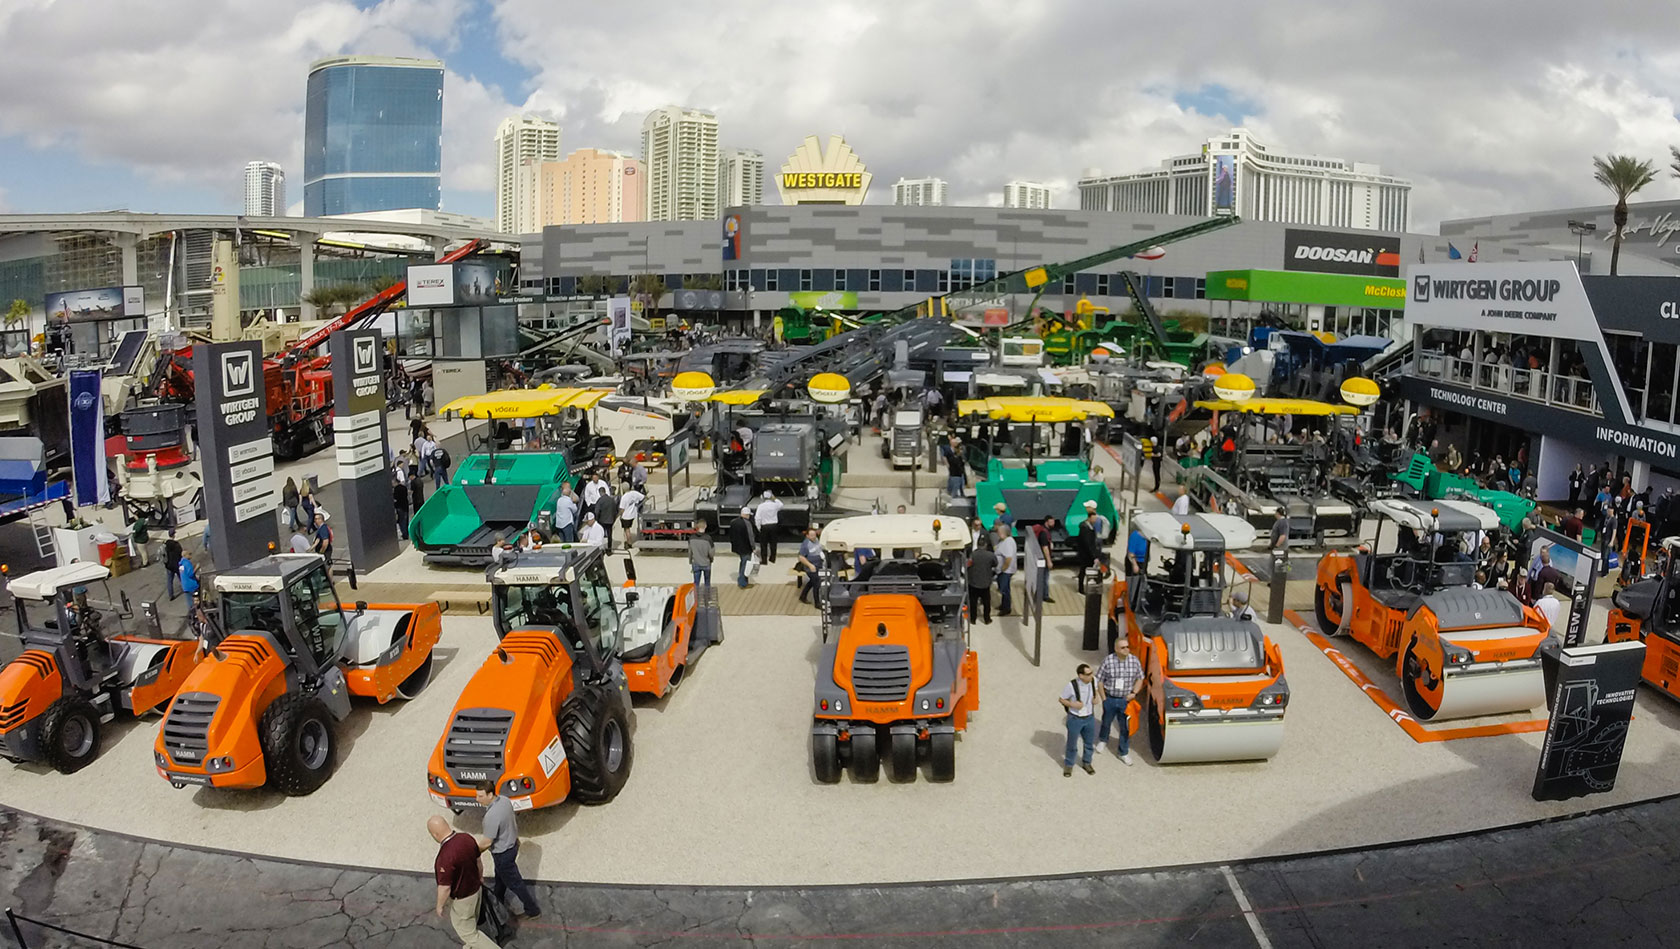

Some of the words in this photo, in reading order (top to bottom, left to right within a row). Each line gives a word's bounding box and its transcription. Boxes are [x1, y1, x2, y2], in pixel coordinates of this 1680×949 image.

[783, 173, 861, 188] WESTGATE
[1294, 245, 1373, 264] DOOSAN
[1433, 279, 1497, 300] WIRTGEN
[1499, 279, 1560, 302] GROUP
[1481, 309, 1486, 317] A
[1487, 309, 1503, 318] JOHN
[1504, 310, 1523, 319] DEERE
[1524, 311, 1557, 321] COMPANY
[353, 374, 380, 388] WIRTGEN
[355, 384, 378, 397] GROUP
[220, 397, 259, 414] WIRTGEN
[1430, 387, 1477, 407] TECHNOLOGY
[1477, 398, 1507, 415] CENTER
[494, 405, 520, 413] VÖGELE
[225, 410, 257, 426] GROUP
[1596, 426, 1676, 459] INFORMATION
[1568, 611, 1581, 644] NEW
[1596, 695, 1634, 705] TECHNOLOGIES
[1605, 689, 1635, 699] INNOVATIVE
[1541, 732, 1553, 770] INNOVATIVE
[1550, 683, 1563, 731] TECHNOLOGIES
[175, 750, 196, 759] HAMM
[460, 771, 487, 780] HAMM
